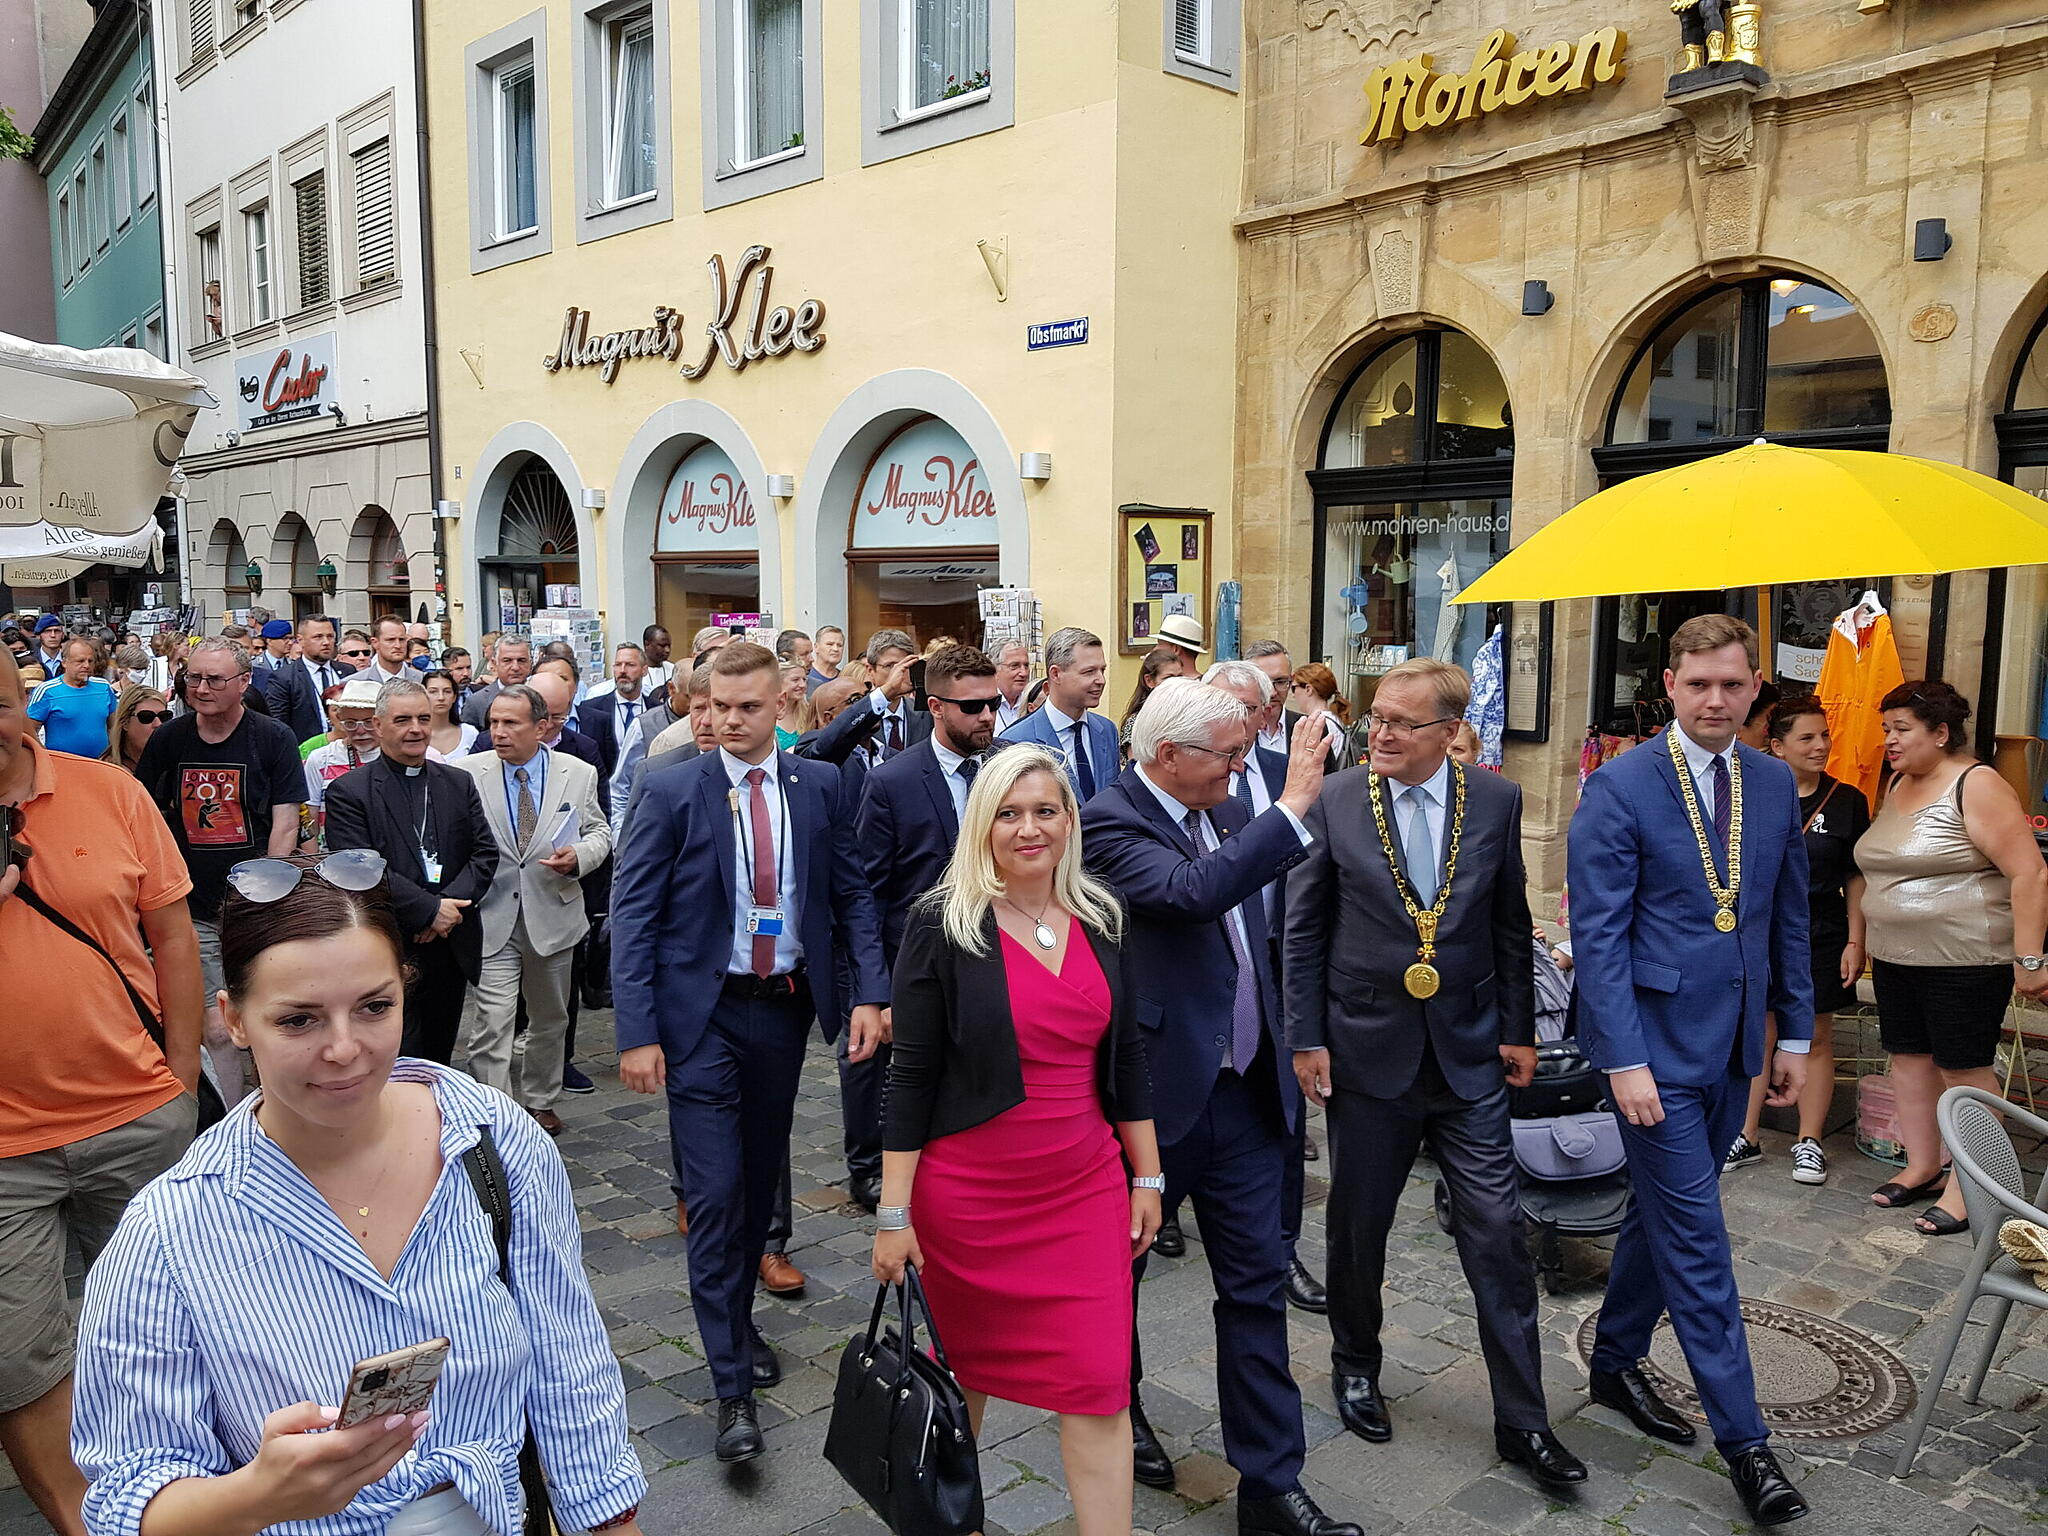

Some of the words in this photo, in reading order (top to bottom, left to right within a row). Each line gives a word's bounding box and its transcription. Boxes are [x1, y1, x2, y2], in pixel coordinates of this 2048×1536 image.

[1359, 28, 1628, 147] Mohren
[542, 306, 684, 384] Magnus
[680, 245, 827, 380] Klee
[1030, 320, 1085, 345] Obstmarkt
[668, 480, 727, 532] Magnus
[867, 463, 946, 524] Magnus
[921, 455, 997, 526] Klee
[44, 527, 95, 546] Alles
[185, 772, 235, 783] LONDON
[185, 783, 235, 801] 2012
